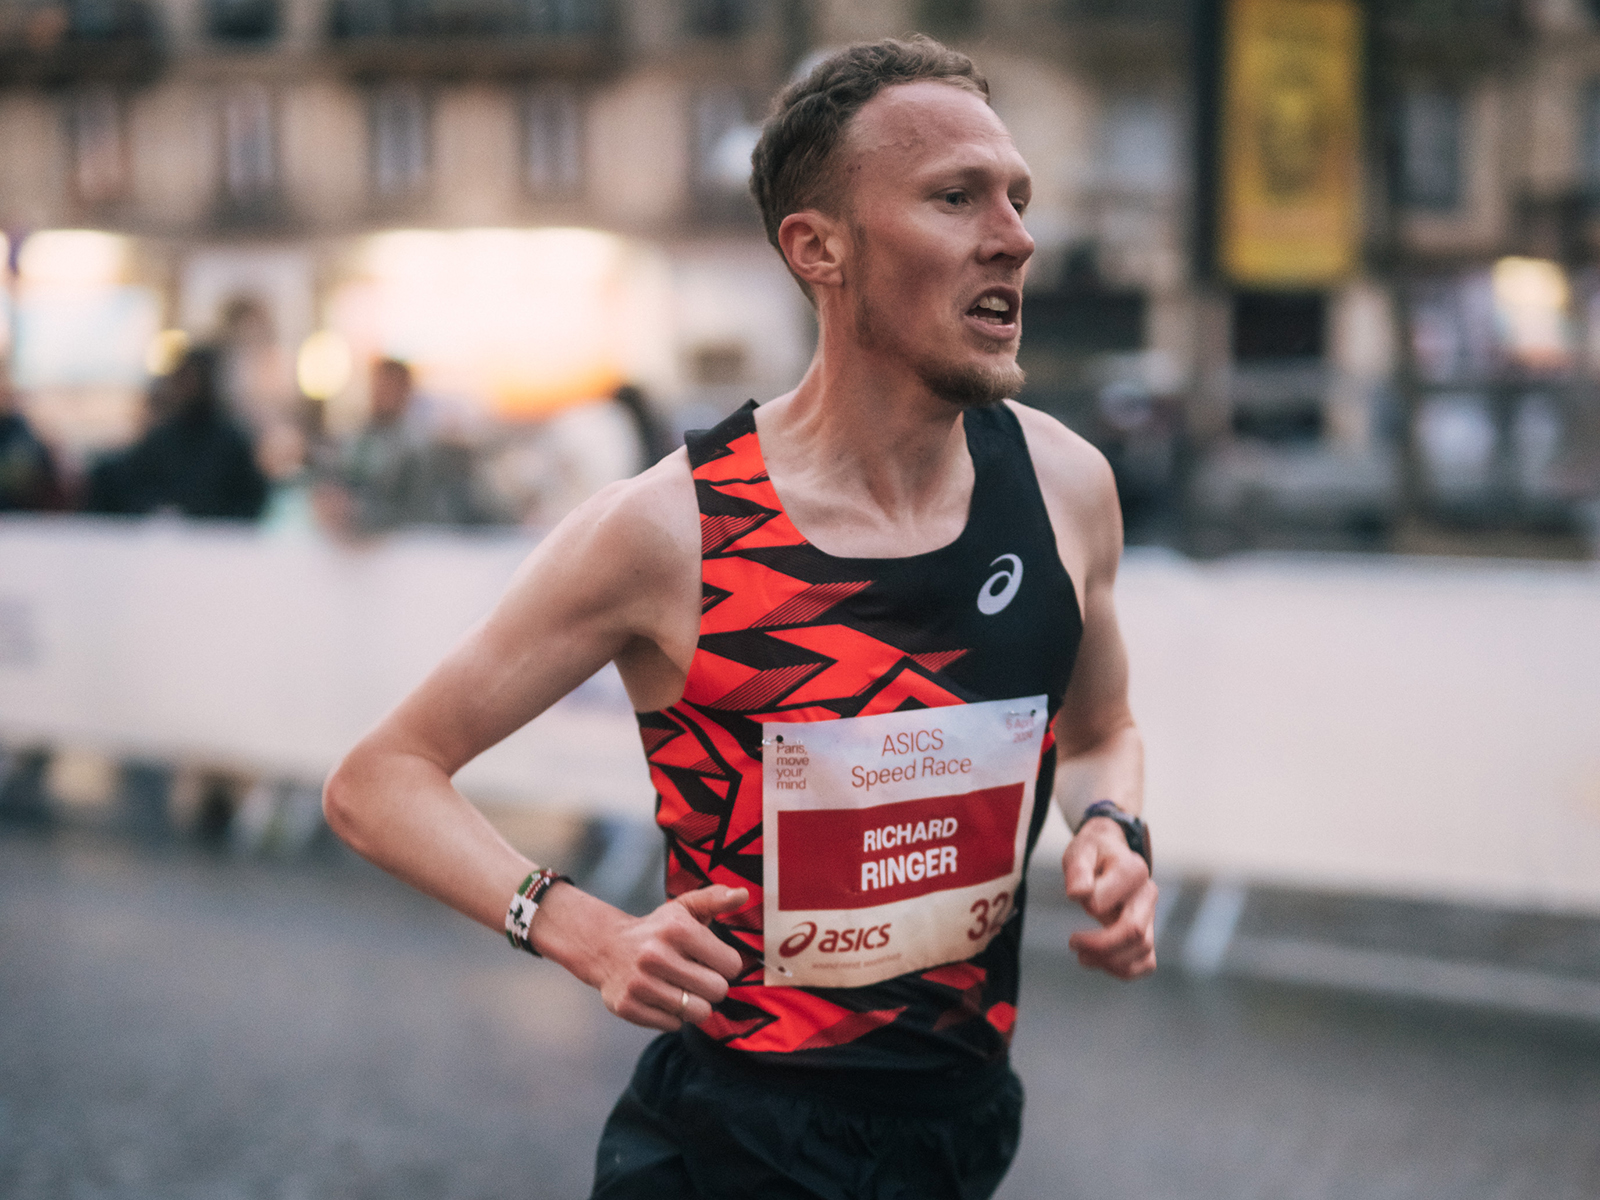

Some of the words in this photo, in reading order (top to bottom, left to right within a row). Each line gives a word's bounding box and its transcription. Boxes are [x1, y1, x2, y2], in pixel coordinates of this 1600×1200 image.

[776, 742, 808, 755] Paris,
[881, 728, 944, 757] ASICS
[776, 756, 810, 766] move
[776, 768, 803, 780] your
[776, 777, 807, 790] mind
[851, 758, 917, 792] Speed
[921, 756, 972, 777] Race
[863, 817, 958, 853] RICHARD
[861, 845, 958, 891] RINGER
